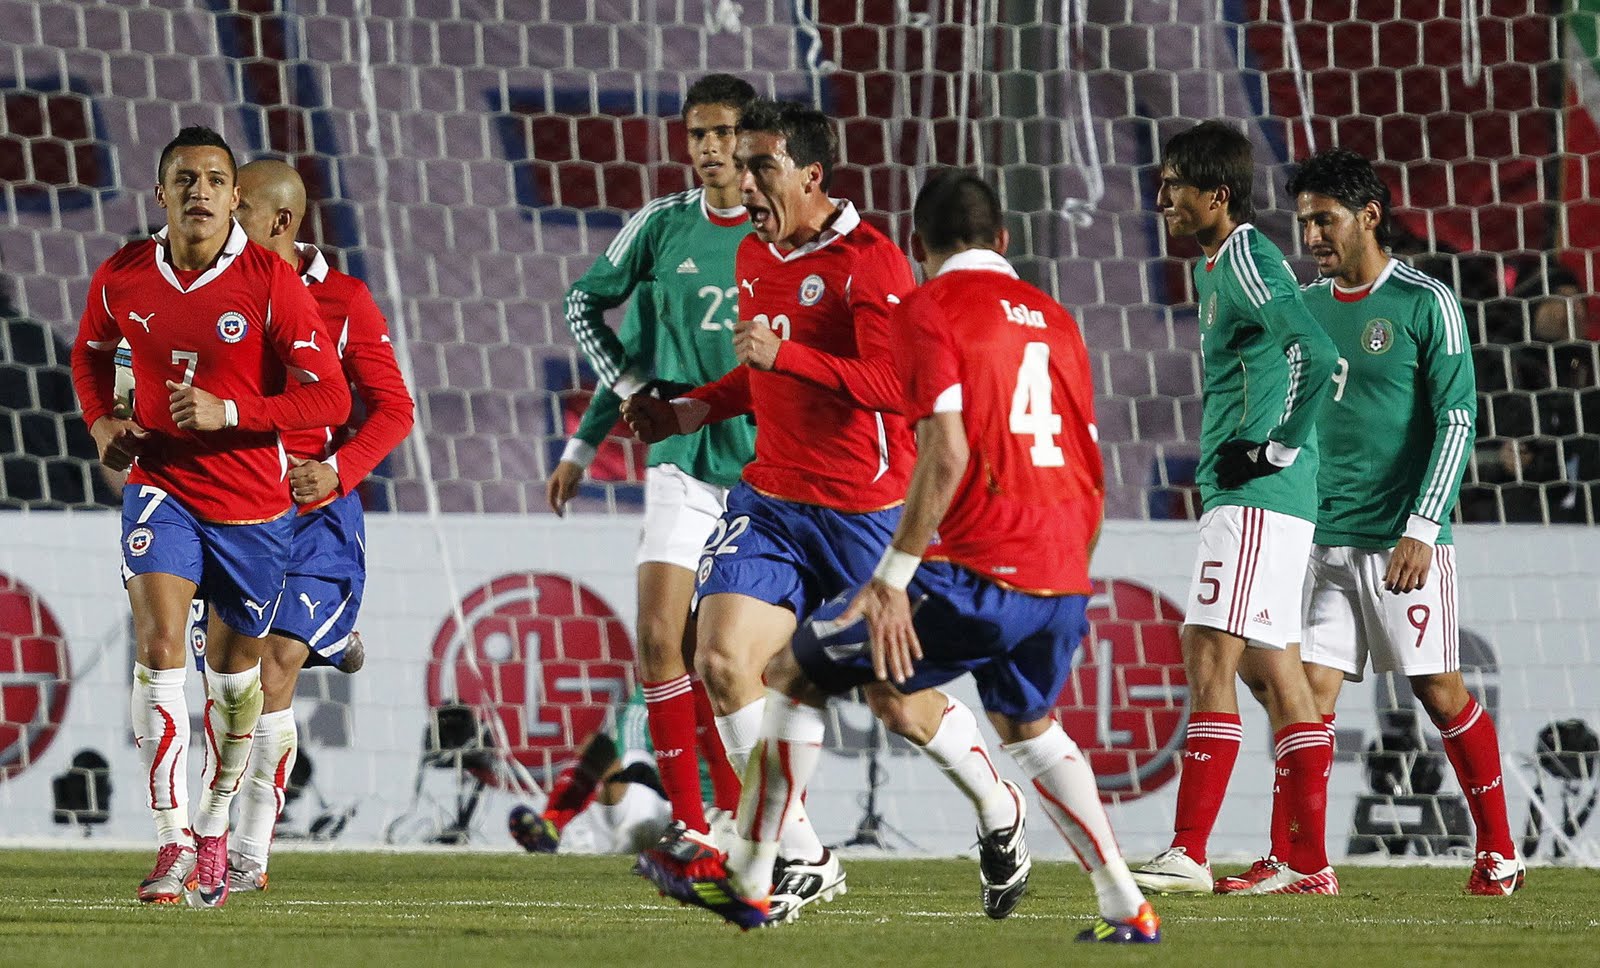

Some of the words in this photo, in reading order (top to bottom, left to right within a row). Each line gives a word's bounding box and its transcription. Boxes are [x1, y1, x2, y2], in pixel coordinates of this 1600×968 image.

[1000, 299, 1048, 329] Isla
[171, 350, 198, 388] 7
[1331, 356, 1349, 402] 9
[1008, 341, 1066, 468] 4
[136, 485, 168, 524] 7
[702, 515, 751, 556] 22
[1197, 560, 1223, 606] 5
[1406, 603, 1431, 649] 9
